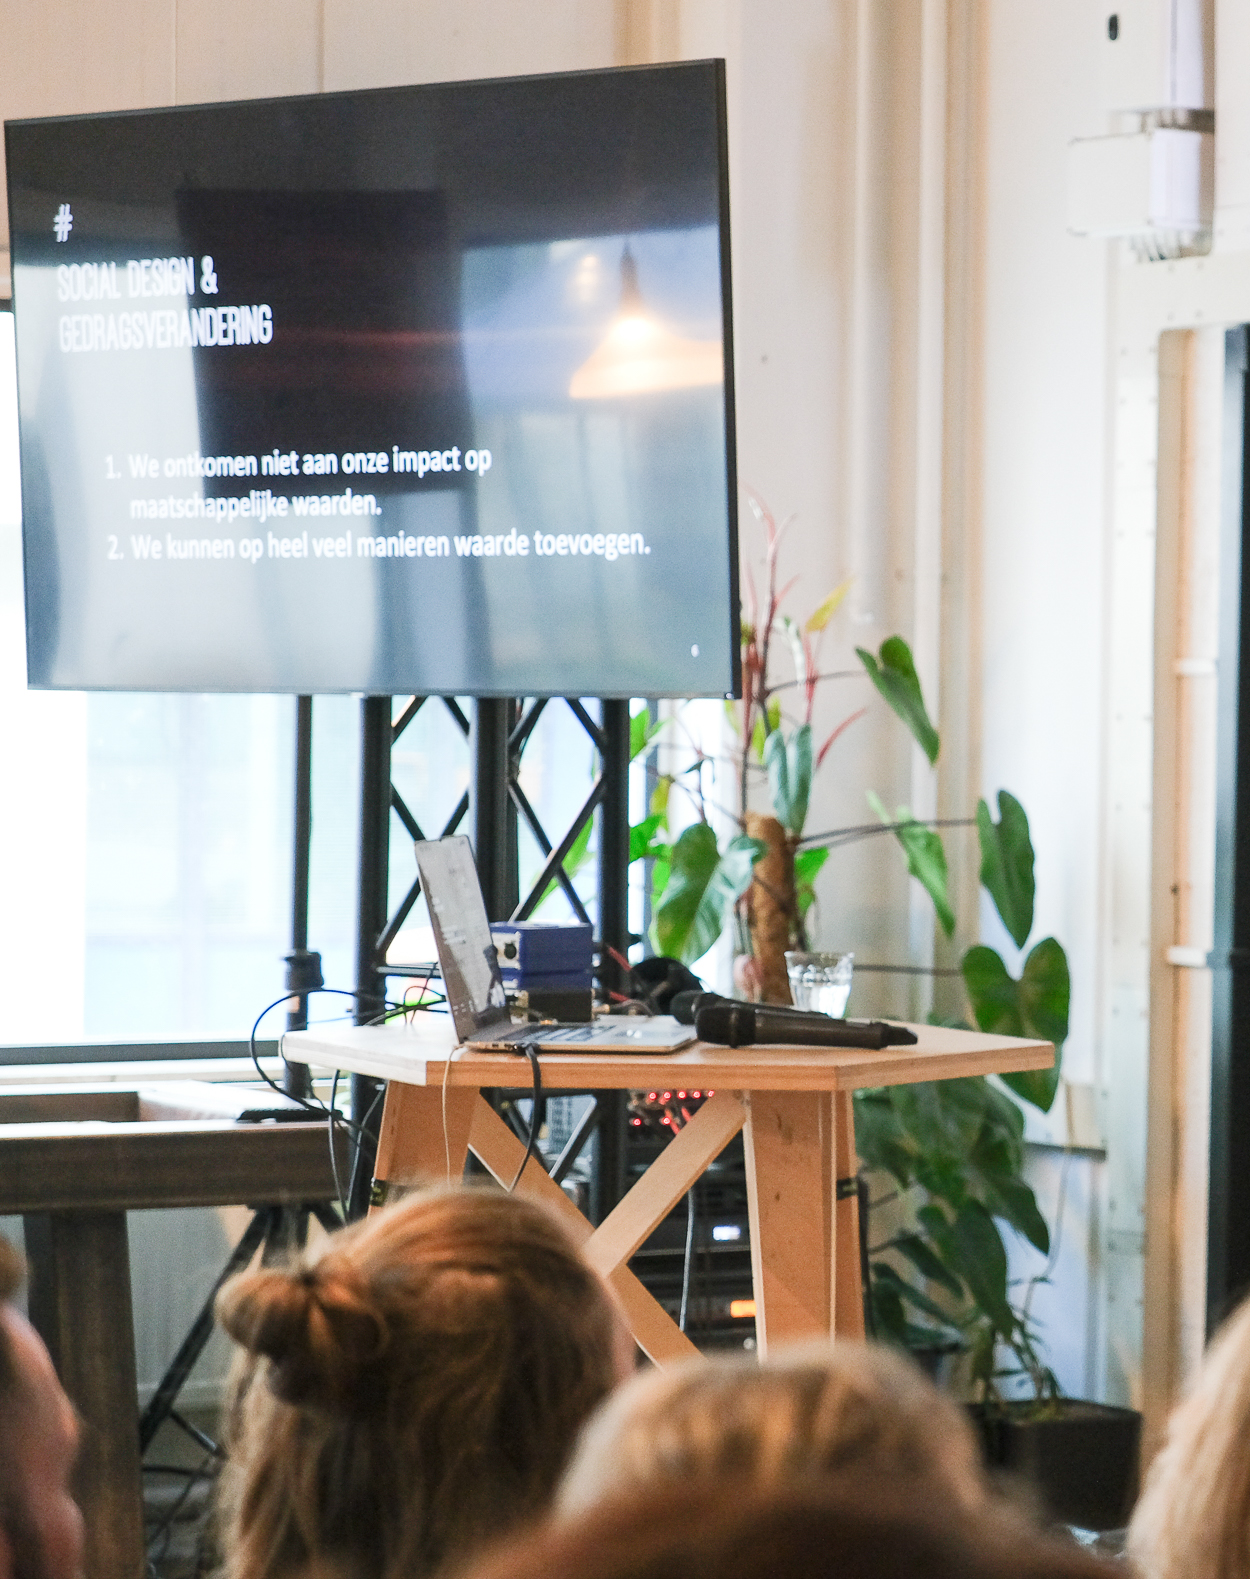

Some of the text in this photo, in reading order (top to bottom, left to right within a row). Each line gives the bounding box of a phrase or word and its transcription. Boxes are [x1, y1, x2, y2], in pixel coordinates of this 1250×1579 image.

[53, 203, 73, 242] #
[58, 255, 219, 302] SOCIAL DESIGN &
[59, 304, 273, 353] GEDRAGSVERANDERING
[105, 445, 492, 479] 1. We ontkomen niet aan onze impact op
[129, 487, 382, 523] maatschappelijke waarden.
[108, 527, 651, 564] 2. We kunnen op heel veel manieren waarde toevoegen.
